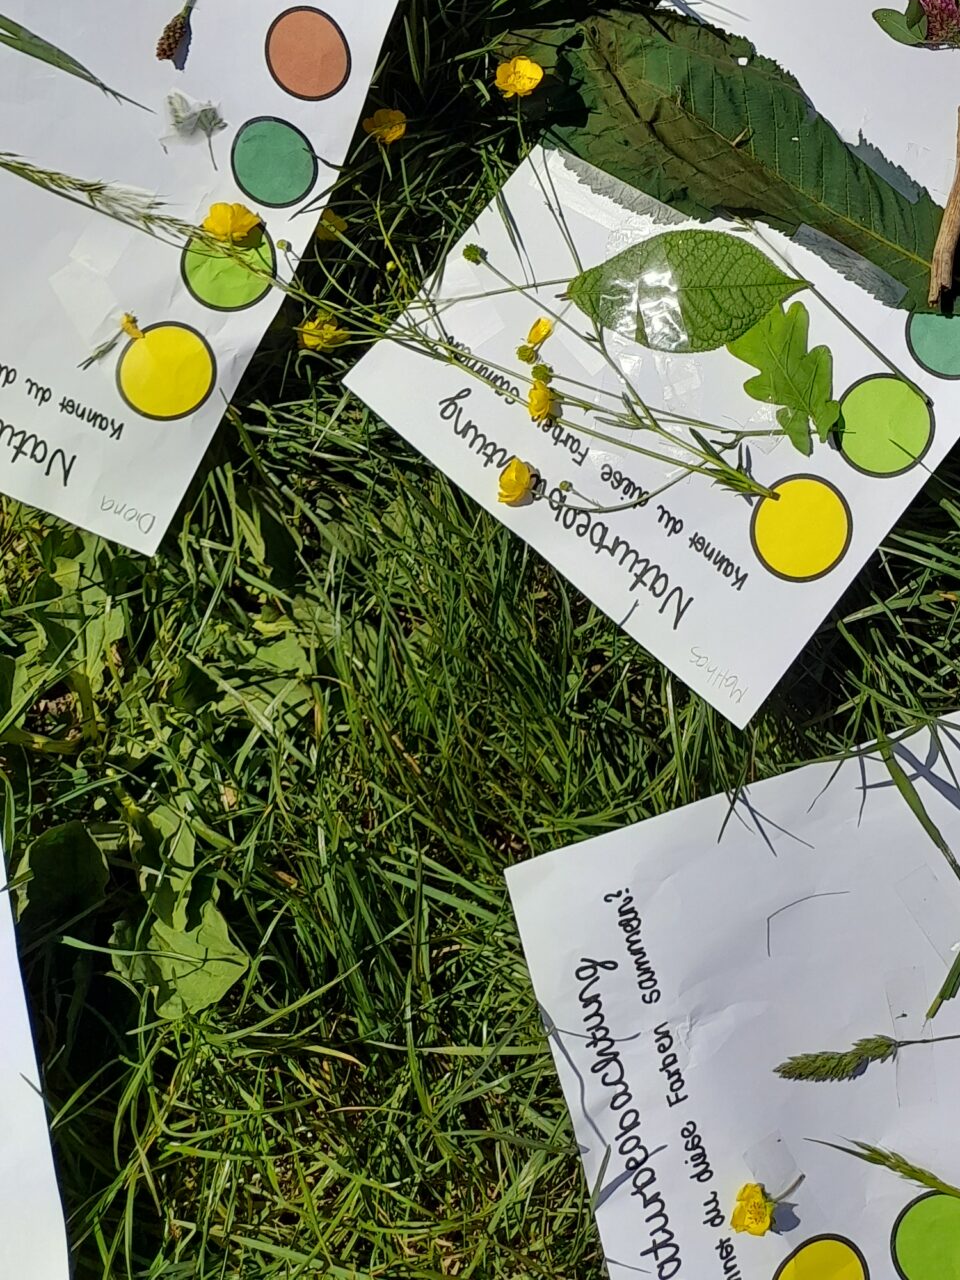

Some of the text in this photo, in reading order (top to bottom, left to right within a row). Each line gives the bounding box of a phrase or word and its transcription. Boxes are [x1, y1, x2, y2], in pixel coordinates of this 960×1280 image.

[25, 378, 125, 440] Kannst du
[656, 504, 684, 537] du
[688, 531, 749, 592] Kannst
[603, 886, 661, 1004] sammeln?
[654, 1021, 689, 1108] Farben
[680, 1120, 714, 1184] diese
[703, 1191, 725, 1227] du
